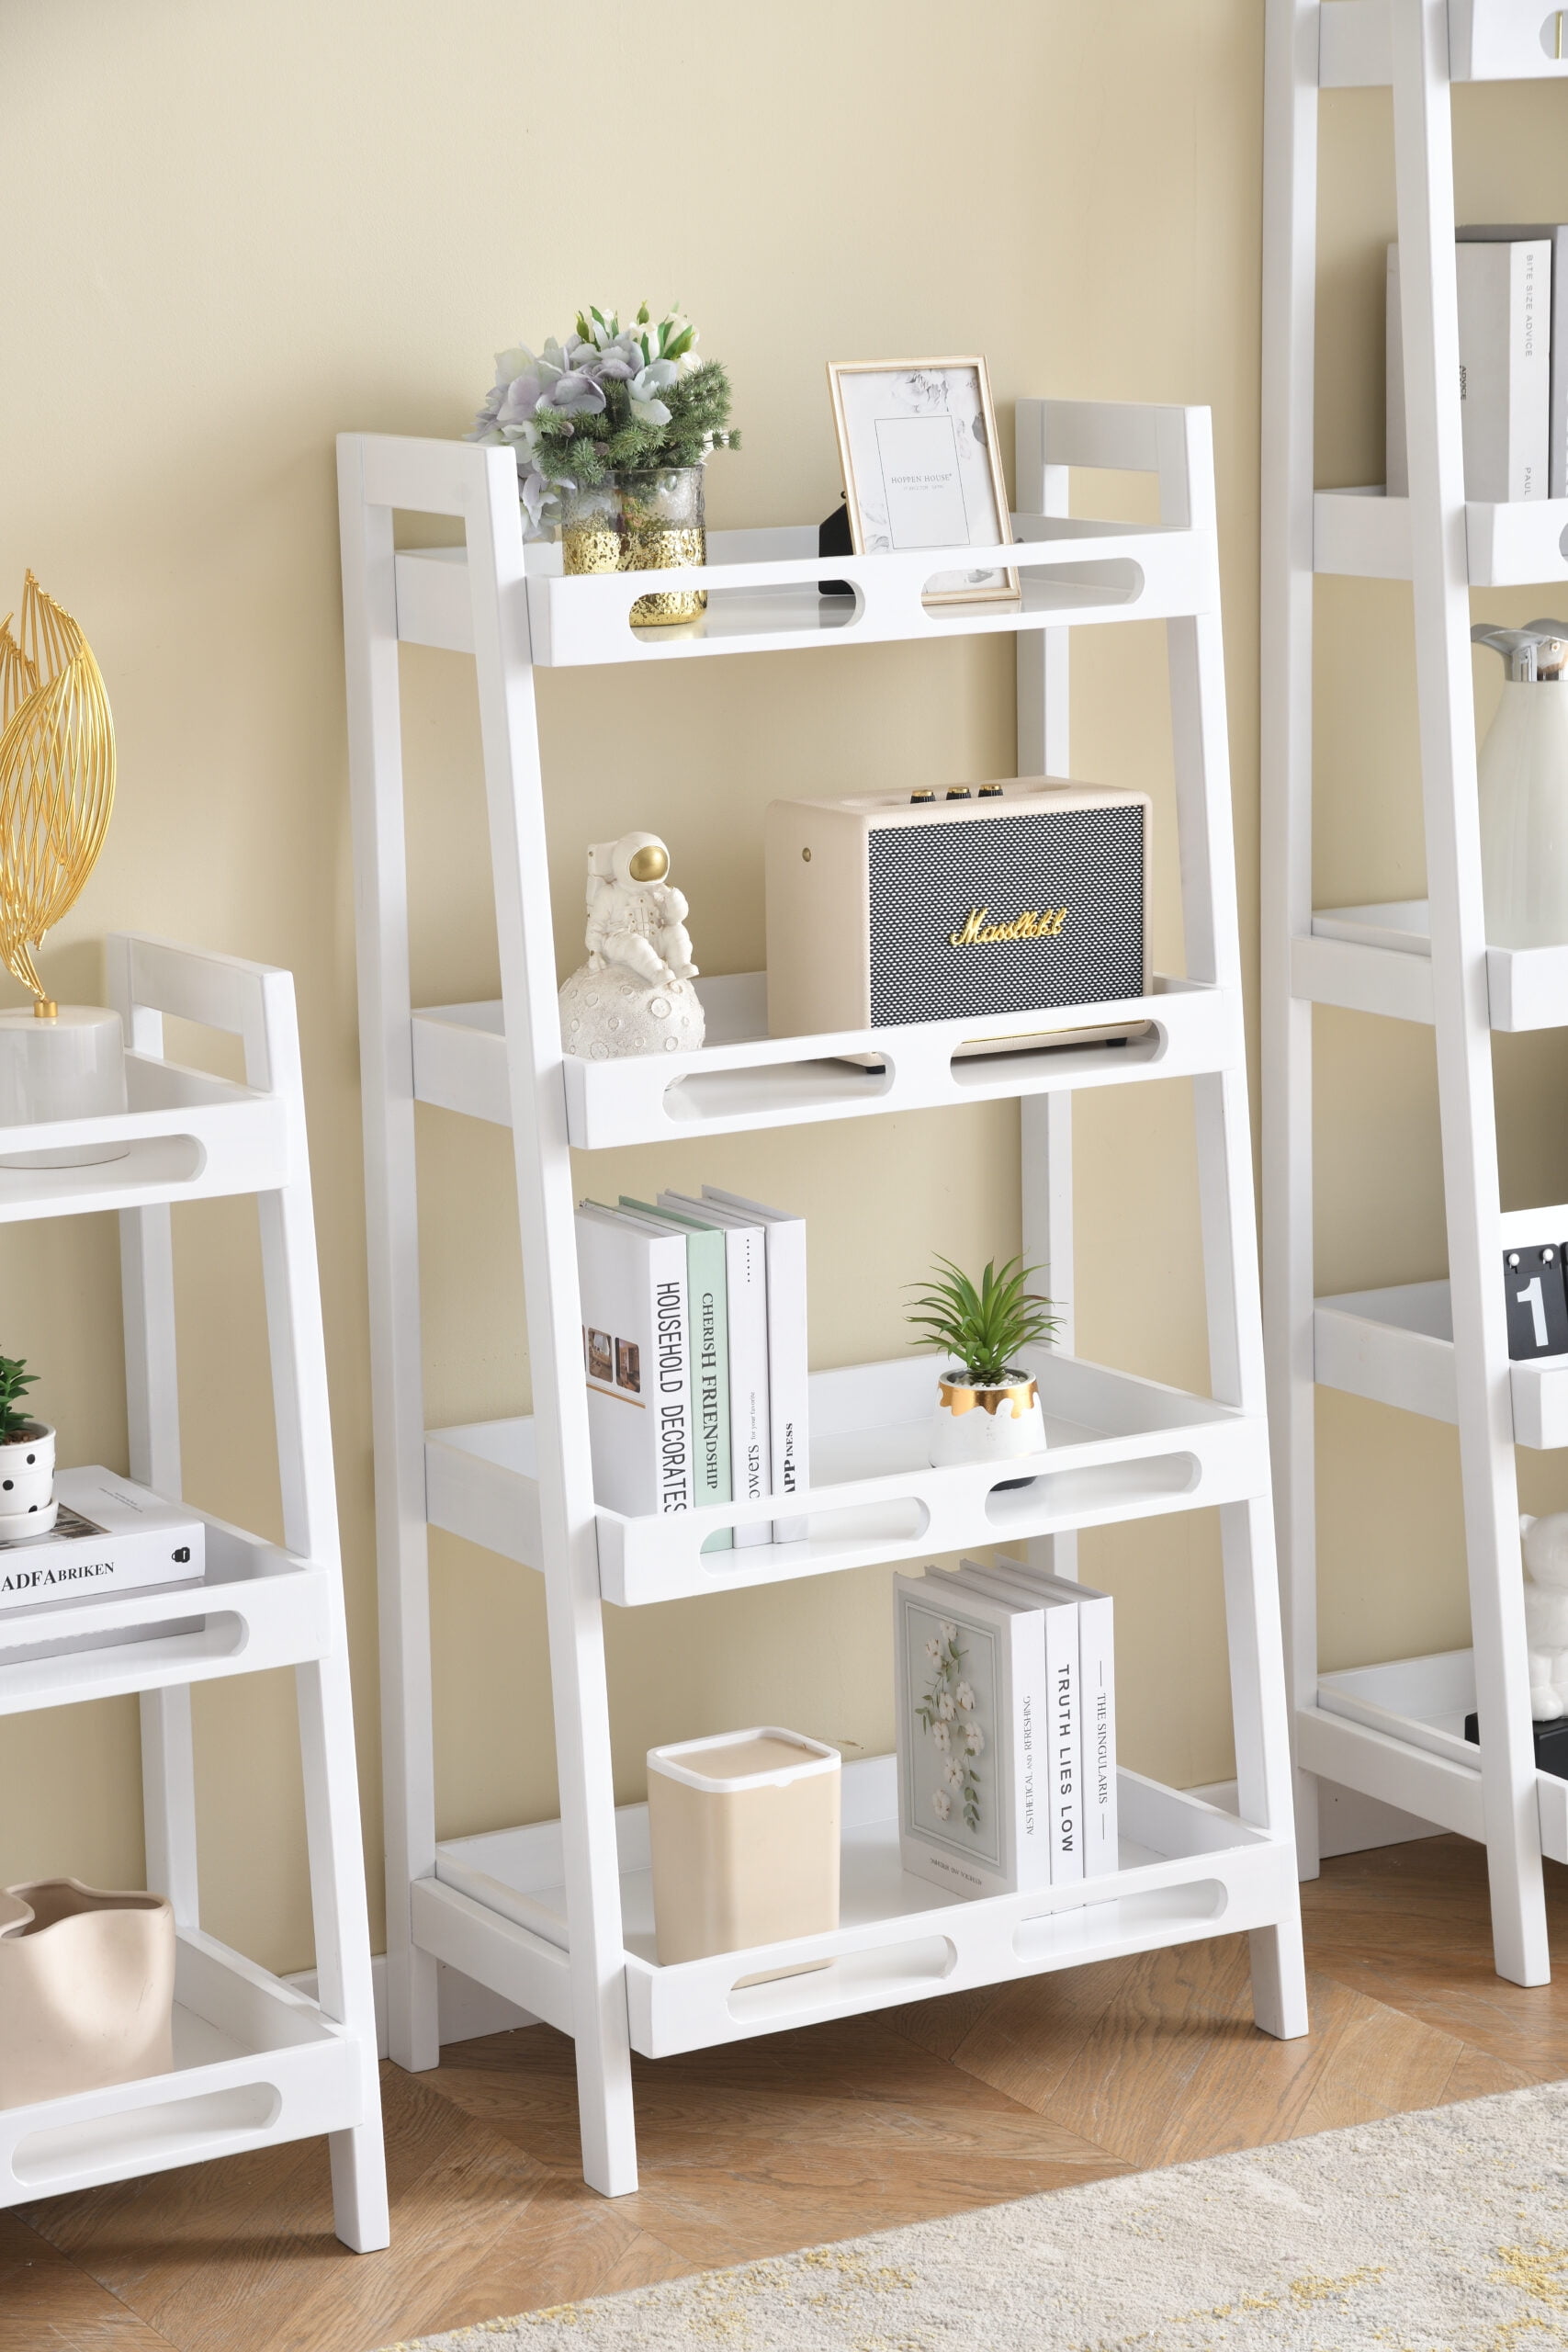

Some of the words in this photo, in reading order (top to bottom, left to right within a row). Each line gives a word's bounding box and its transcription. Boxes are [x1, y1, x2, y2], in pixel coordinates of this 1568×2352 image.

[1526, 254, 1534, 280] BITE
[1525, 315, 1533, 357] ADVICE
[891, 475, 922, 484] HOPPEN
[1524, 467, 1532, 496] PAUL
[657, 1282, 683, 1394] HOUSEHOLD
[701, 1292, 716, 1369] CHERISH
[1517, 1276, 1549, 1347] 1
[660, 1405, 687, 1513] DECORATES
[702, 1375, 718, 1489] FRIENDSHIP
[1057, 1664, 1071, 1736] TRUTH
[1097, 1692, 1106, 1721] THE
[1059, 1747, 1073, 1795] LIES
[1097, 1724, 1108, 1805] SINGULARIS
[1061, 1805, 1074, 1852] LOW
